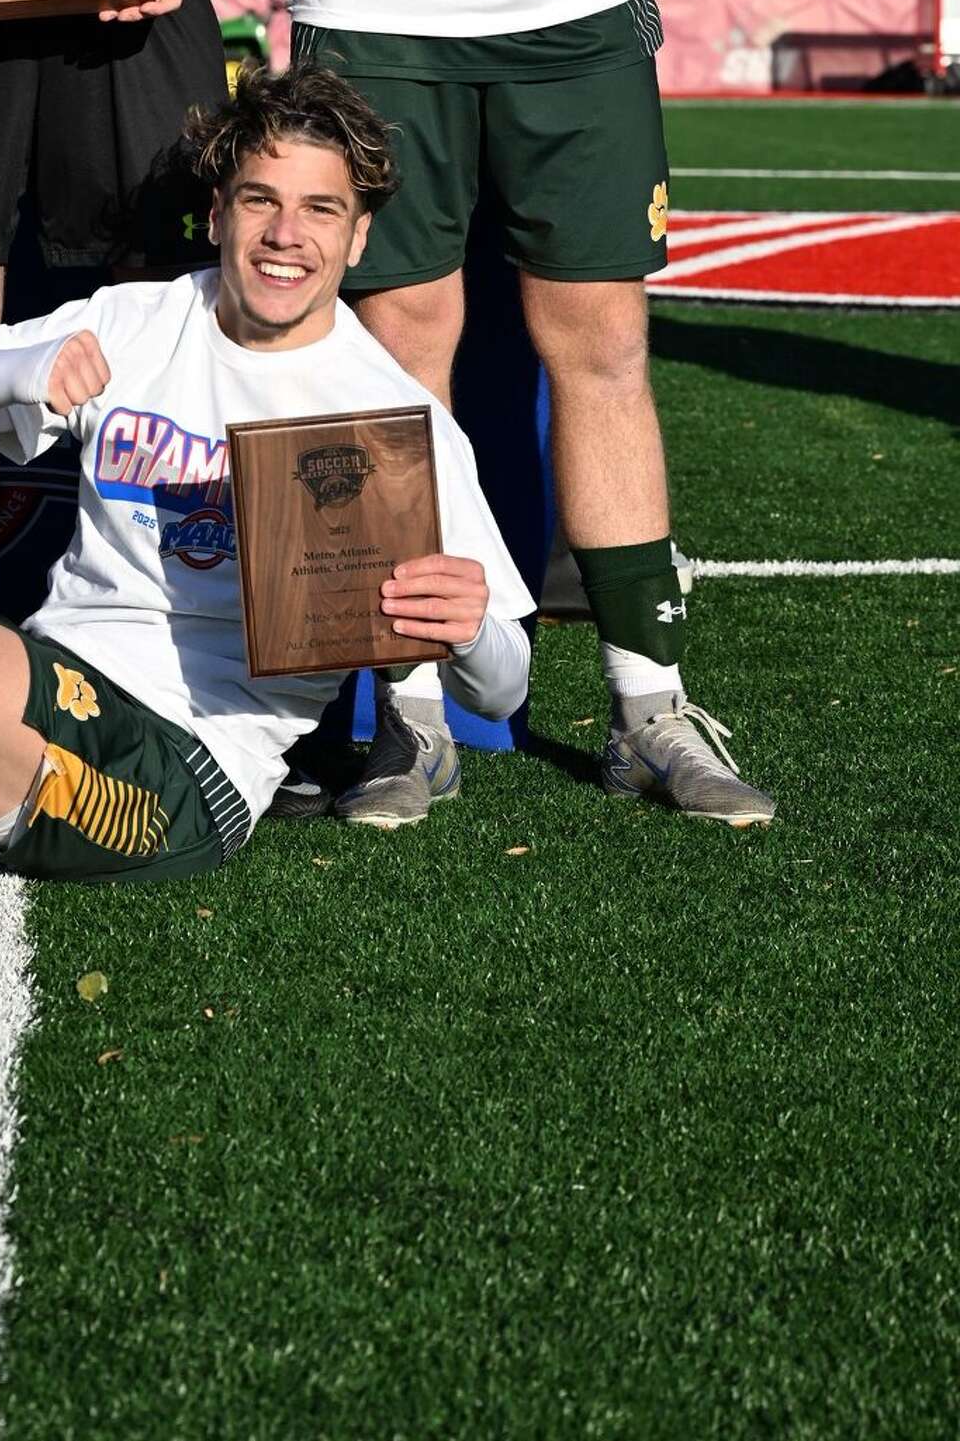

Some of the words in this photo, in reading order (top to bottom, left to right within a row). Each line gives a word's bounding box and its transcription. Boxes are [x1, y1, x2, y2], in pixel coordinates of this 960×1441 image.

[307, 455, 360, 472] SOCCER
[131, 510, 158, 529] 2025
[304, 550, 336, 562] Metro
[340, 546, 382, 559] Atlantic
[290, 565, 333, 577] Athletic
[336, 559, 397, 572] Conference
